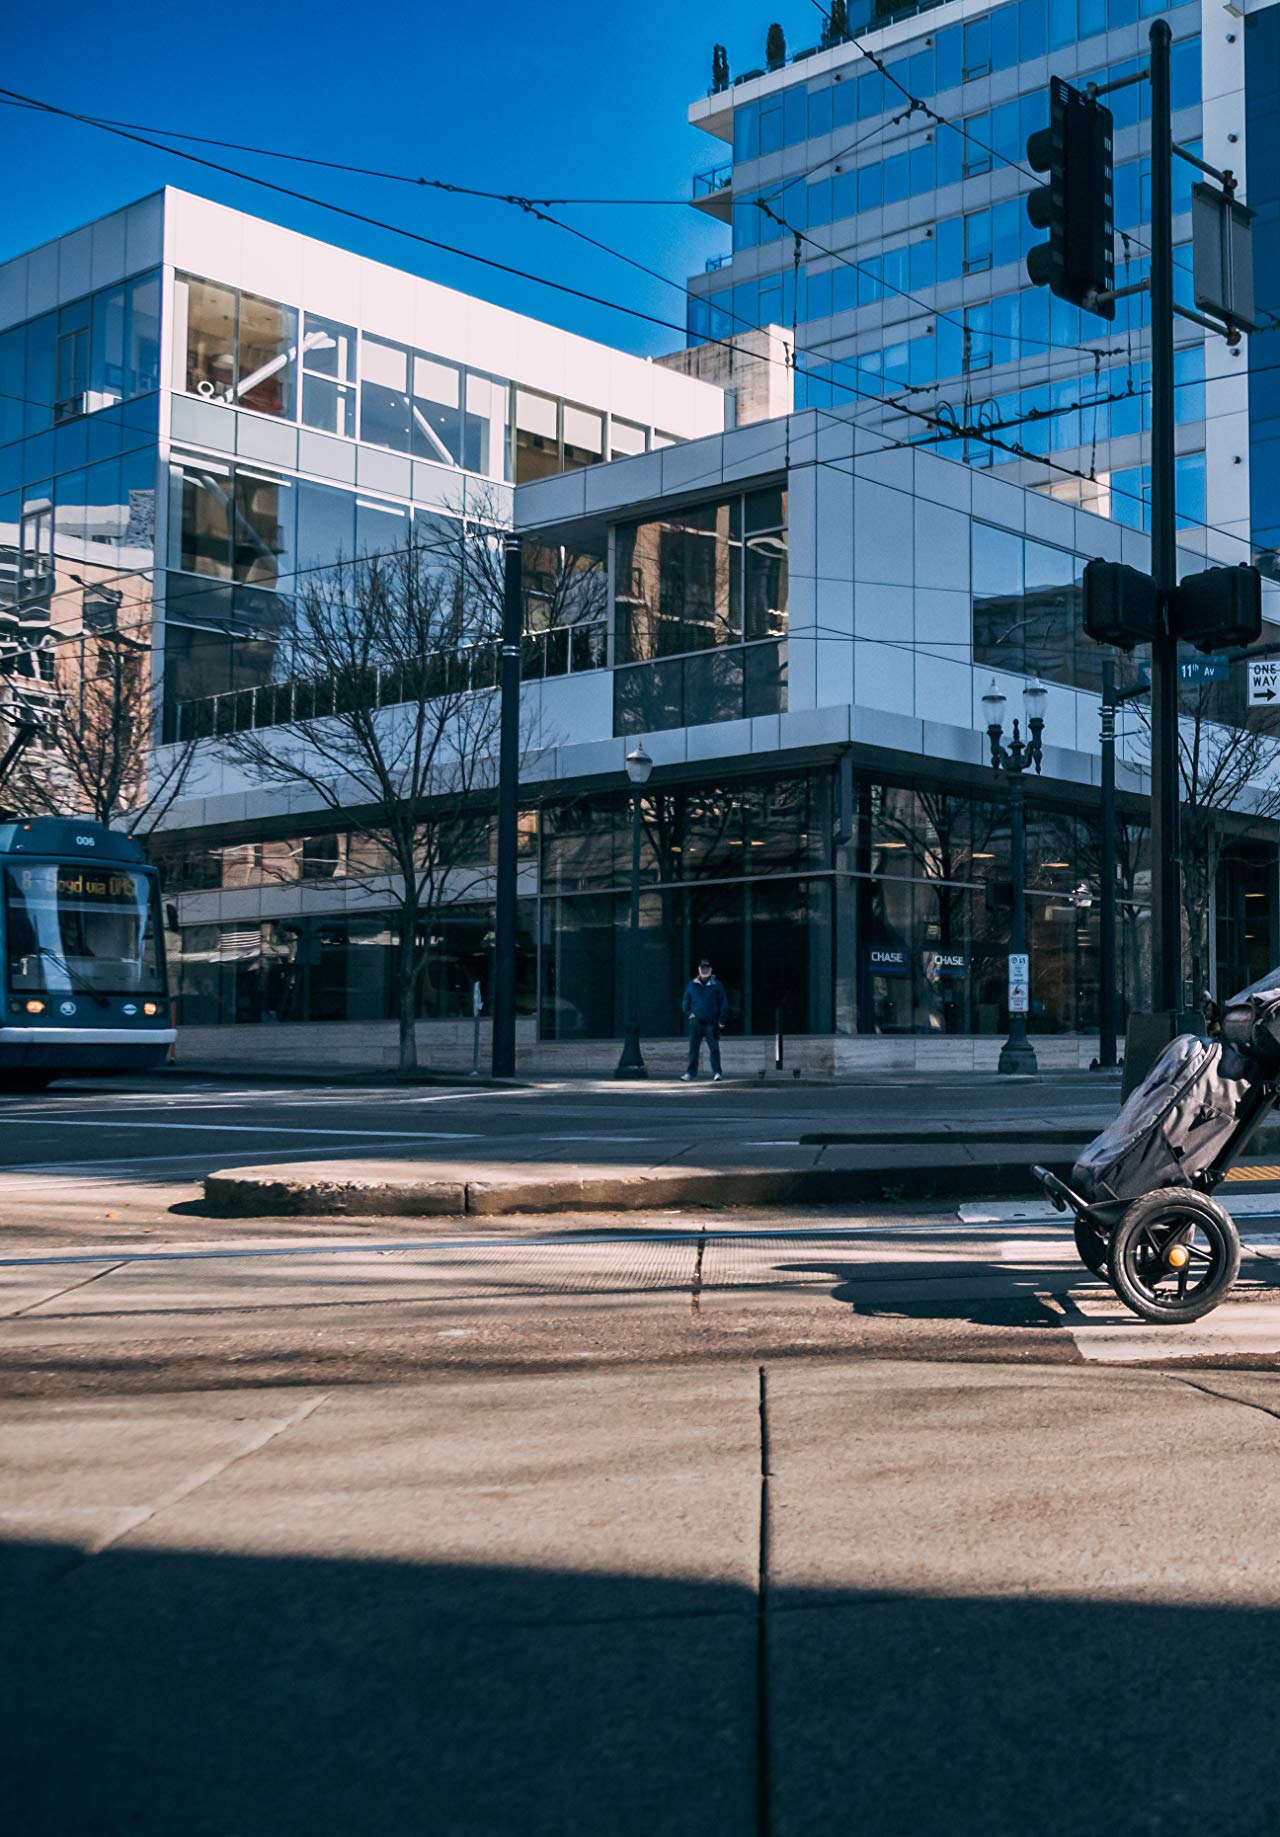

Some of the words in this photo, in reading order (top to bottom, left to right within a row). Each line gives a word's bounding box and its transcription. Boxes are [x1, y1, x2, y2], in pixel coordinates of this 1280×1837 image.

[1181, 664, 1199, 678] 11th
[1254, 664, 1277, 675] ONE
[1253, 676, 1277, 687] WAY
[86, 878, 106, 895] via
[871, 951, 904, 963] CHASE
[934, 955, 964, 966] CHASE
